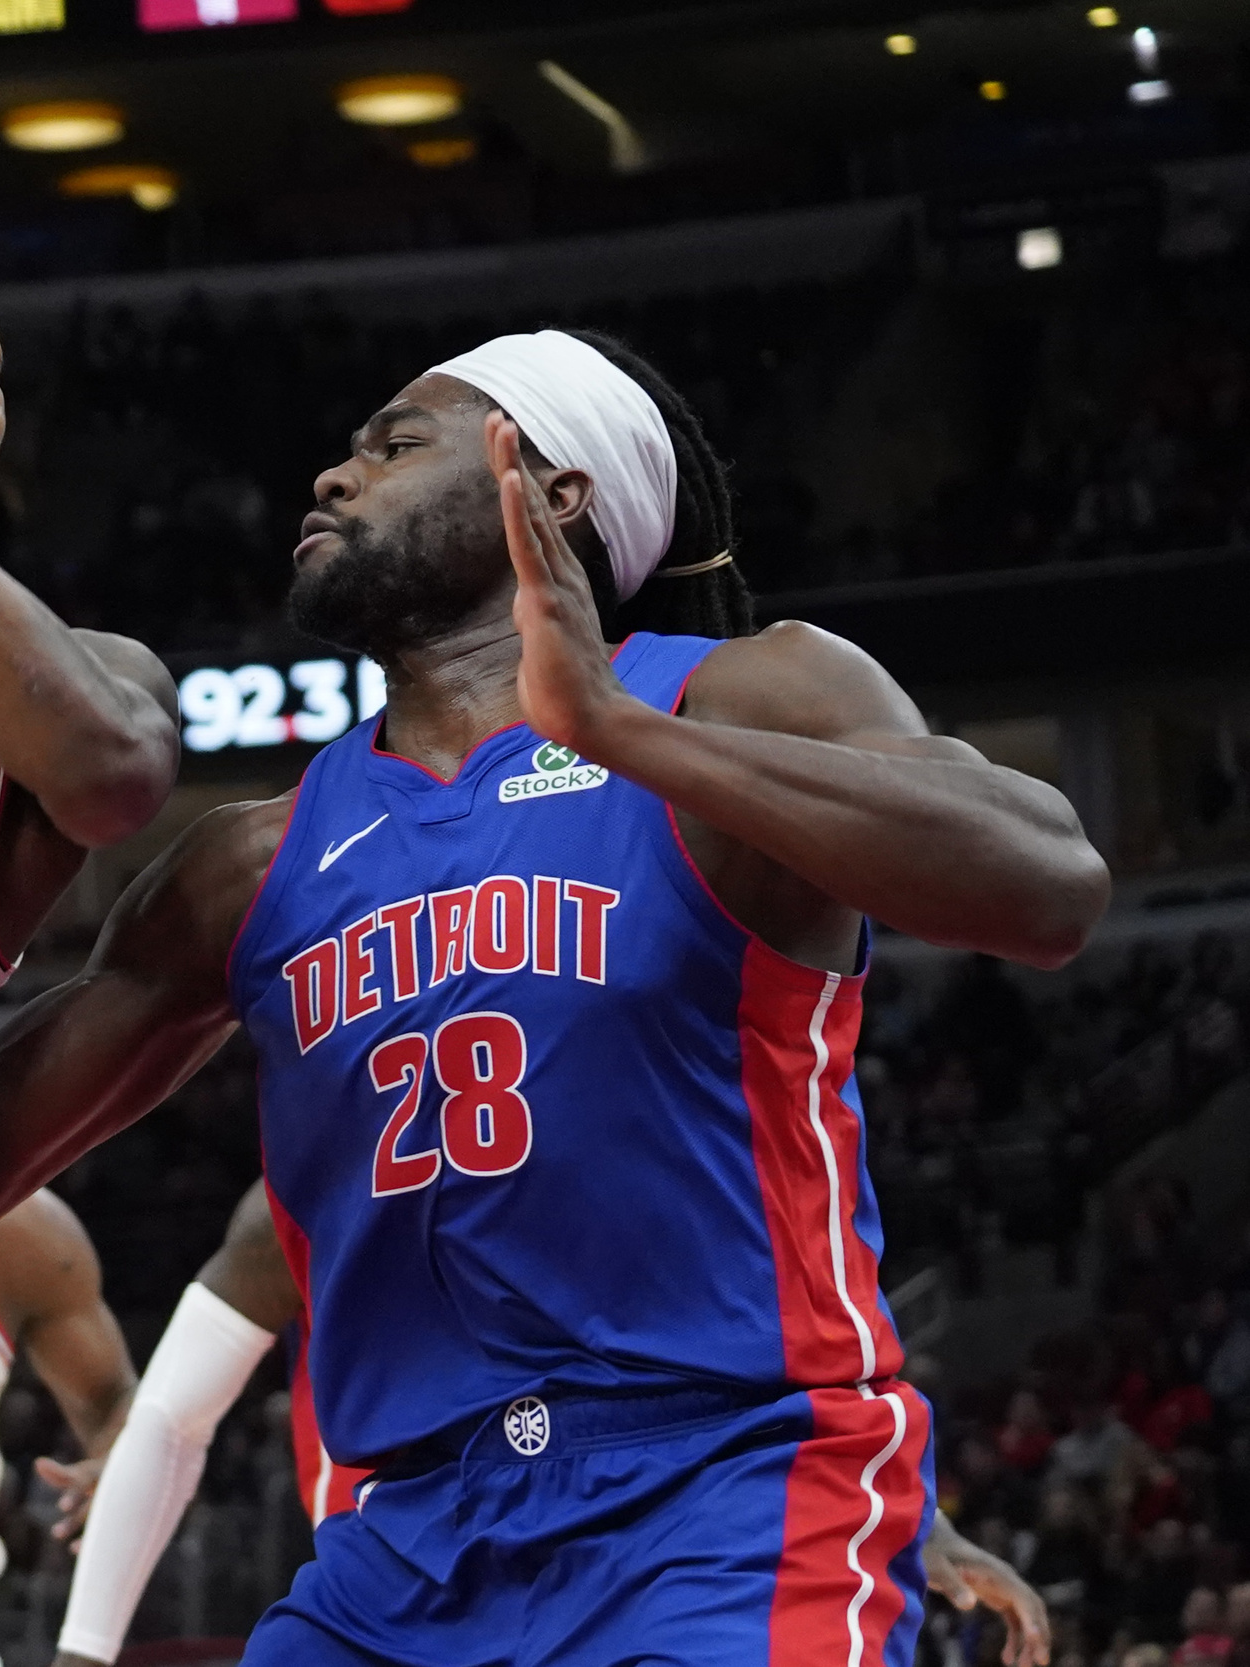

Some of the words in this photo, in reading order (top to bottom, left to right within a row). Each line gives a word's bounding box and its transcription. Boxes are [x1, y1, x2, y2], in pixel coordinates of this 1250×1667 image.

[178, 658, 351, 753] 92.3
[503, 765, 604, 798] StockX
[283, 875, 621, 1056] DETROIT
[368, 1011, 533, 1198] 28
